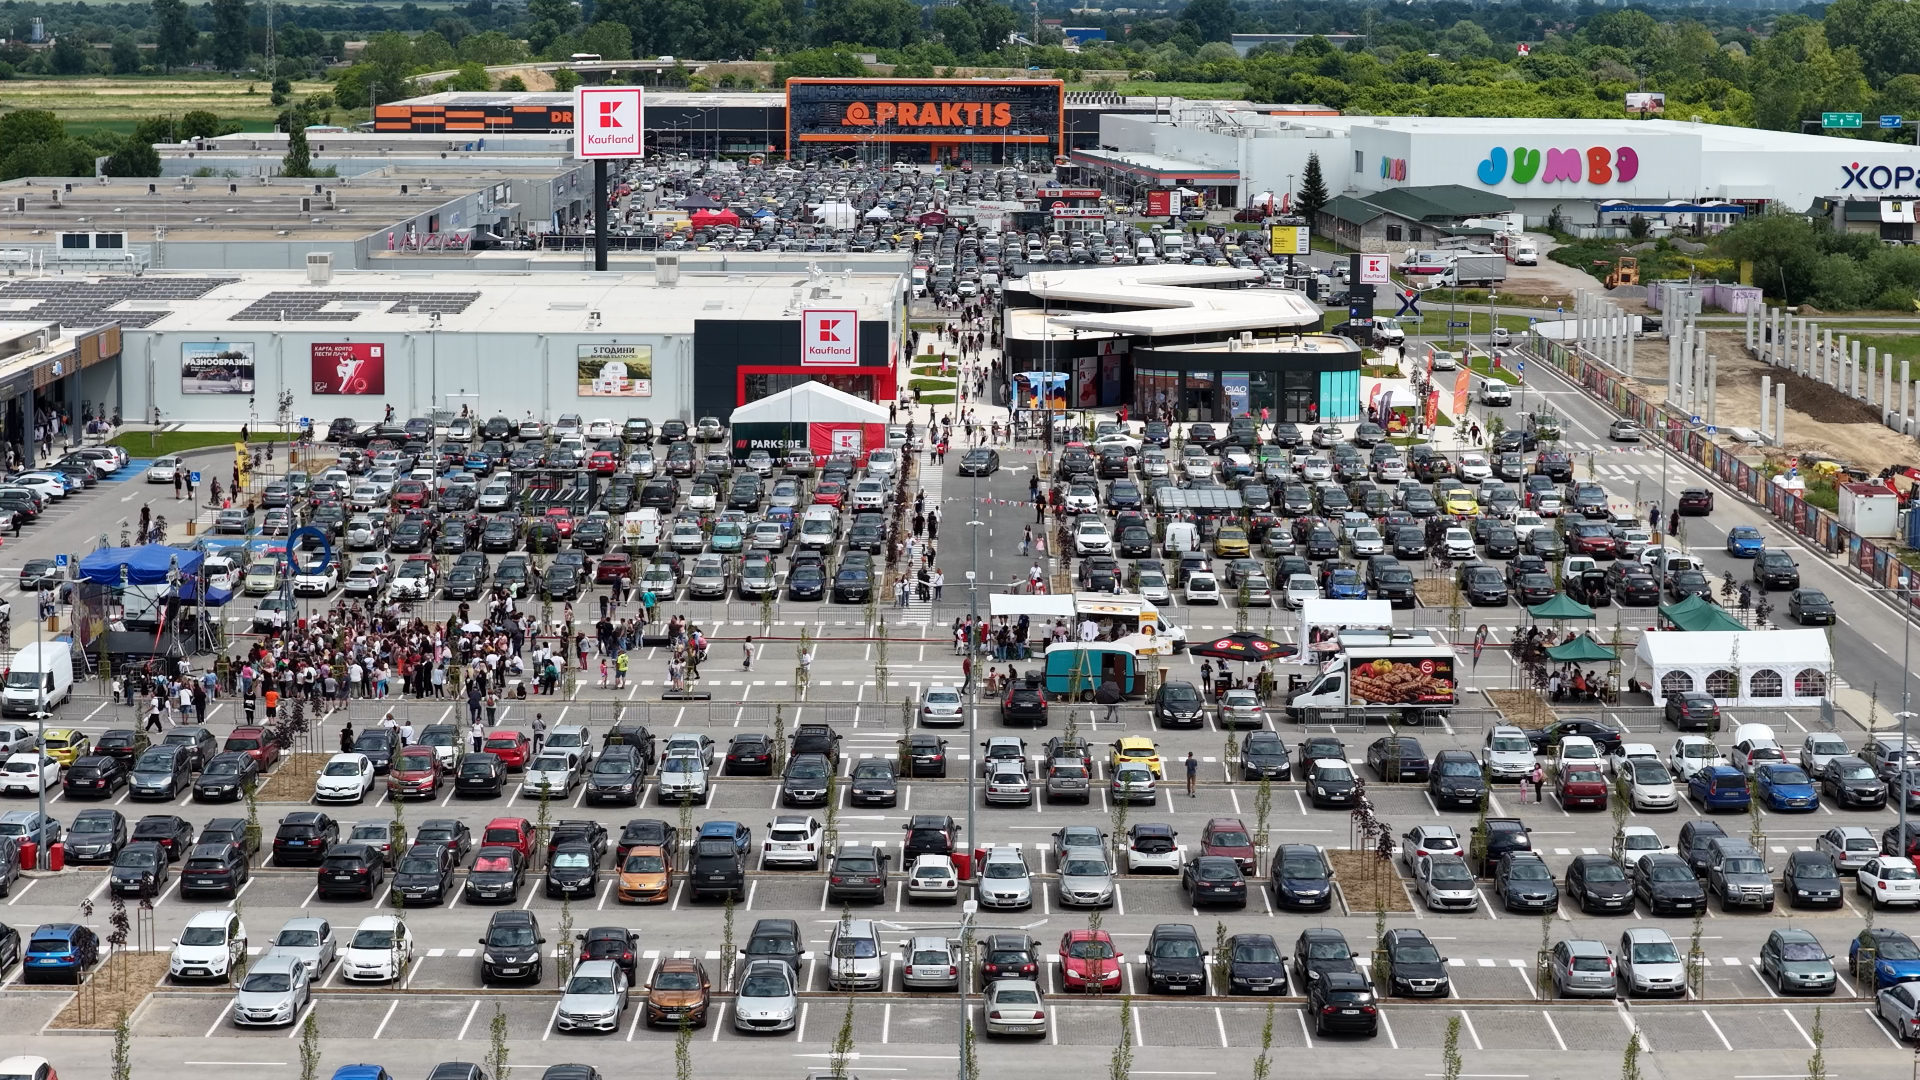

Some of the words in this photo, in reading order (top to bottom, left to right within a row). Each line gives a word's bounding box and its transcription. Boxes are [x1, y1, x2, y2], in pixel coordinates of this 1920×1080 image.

[876, 102, 1012, 127] PRAKTIS
[588, 133, 635, 145] Kaufland
[1380, 155, 1407, 182] JUMBO
[1477, 146, 1639, 186] JUMBO
[1841, 162, 1920, 190] XOP
[809, 346, 851, 355] Kaufland
[1224, 385, 1247, 393] CIAO
